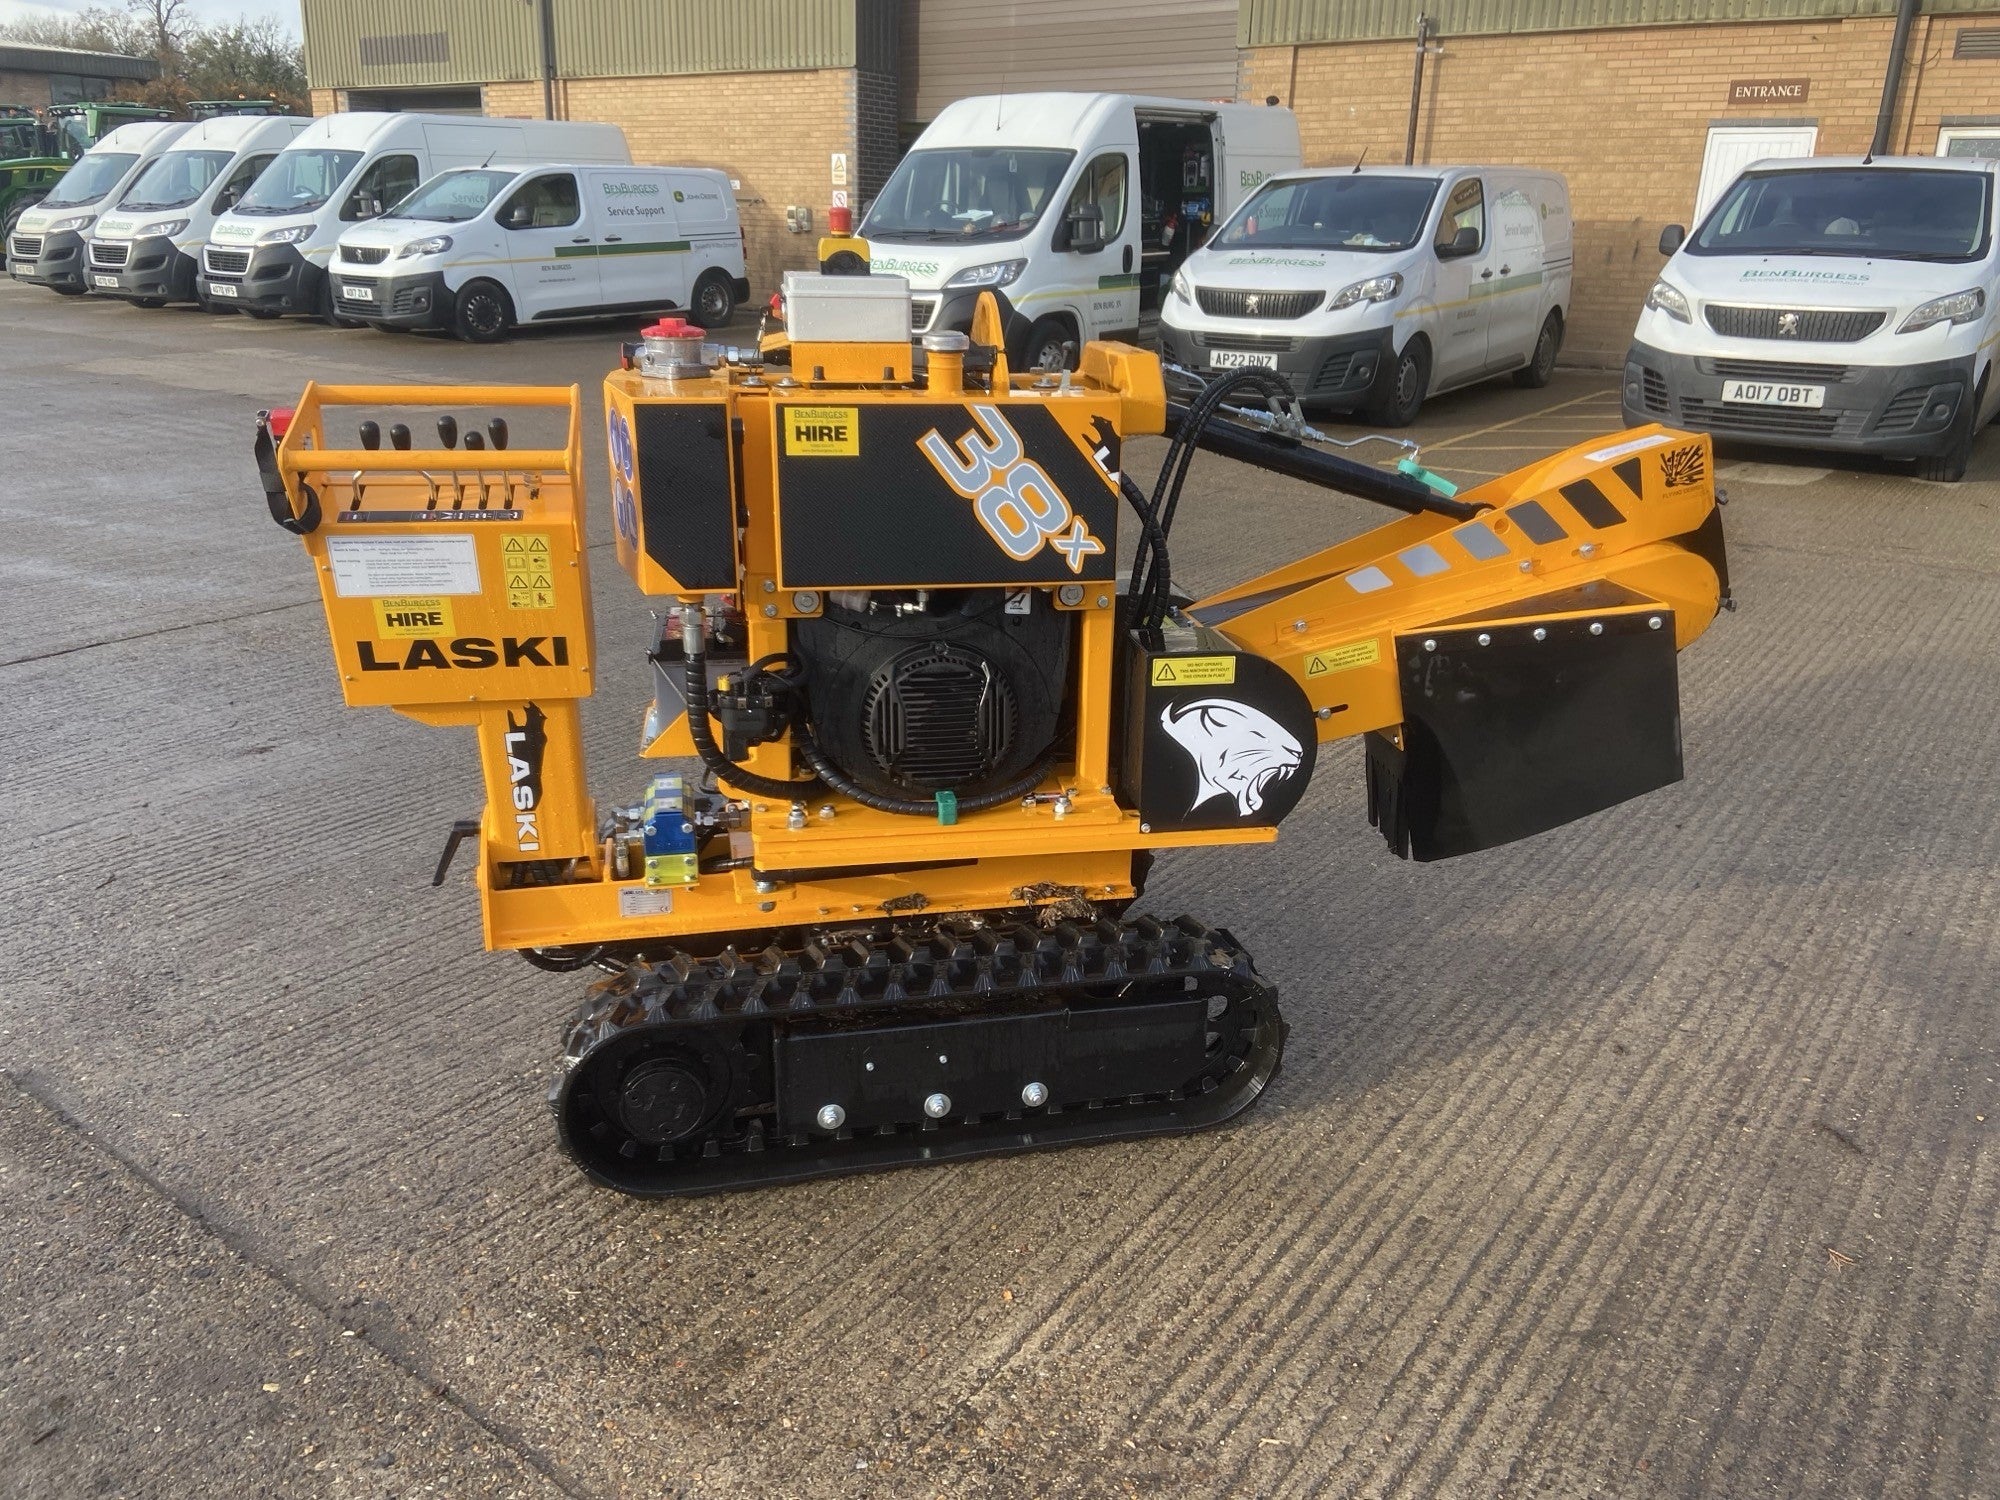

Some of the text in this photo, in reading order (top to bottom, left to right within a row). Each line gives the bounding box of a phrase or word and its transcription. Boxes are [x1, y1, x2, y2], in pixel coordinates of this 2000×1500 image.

[1736, 85, 1802, 98] ENTRANCE
[452, 192, 484, 203] Service
[608, 206, 665, 218] Service Support
[1215, 352, 1272, 368] AP22 RNZ
[1734, 384, 1813, 403] AO17 OBT
[796, 426, 848, 442] HIRE
[386, 612, 444, 627] HIRE
[356, 636, 569, 672] LASKI
[504, 732, 540, 852] LASKI
